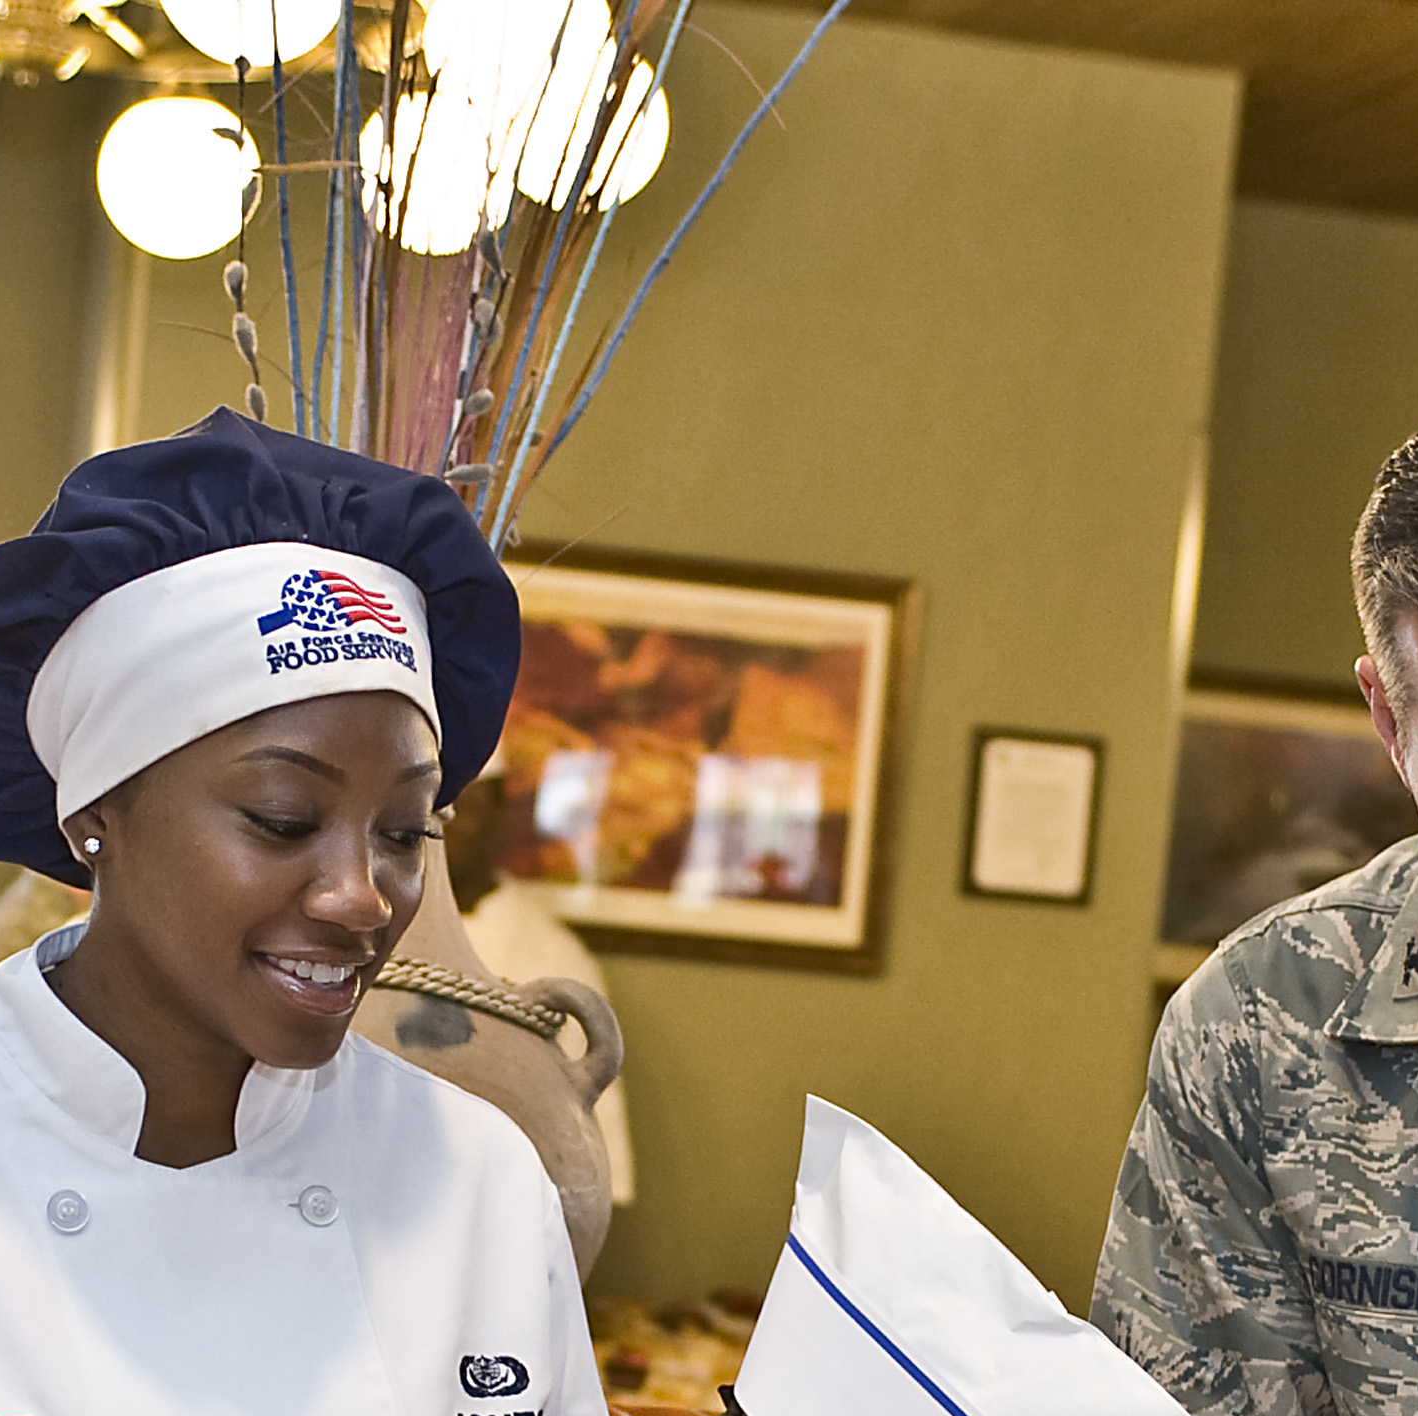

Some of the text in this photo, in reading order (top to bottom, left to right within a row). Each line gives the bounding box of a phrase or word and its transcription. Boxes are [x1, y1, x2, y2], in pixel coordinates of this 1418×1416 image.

[266, 642, 296, 656] AIR
[302, 633, 353, 647] FORCE
[266, 644, 417, 674] FOOD SERVICE
